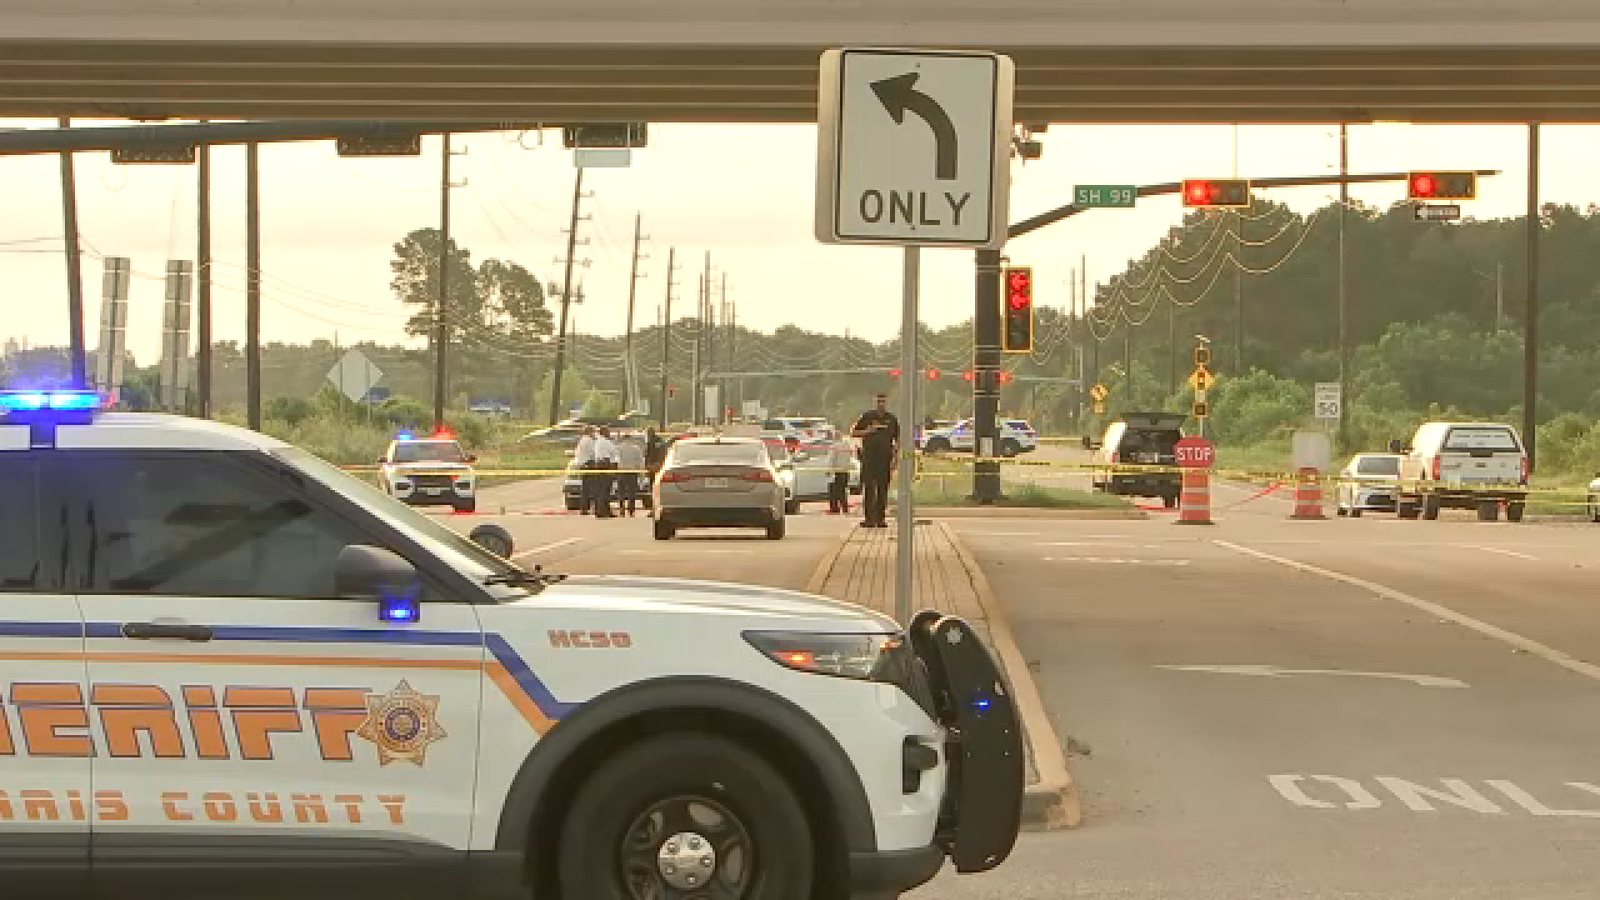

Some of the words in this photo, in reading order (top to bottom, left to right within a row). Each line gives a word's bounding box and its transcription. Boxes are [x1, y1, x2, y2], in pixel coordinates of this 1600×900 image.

[860, 189, 971, 226] ONLY
[1080, 190, 1100, 203] SH
[1110, 190, 1131, 203] 99
[1177, 446, 1211, 461] STOP
[547, 629, 631, 648] HCSO
[0, 682, 372, 761] ERIFF
[161, 791, 406, 825] COUNTY
